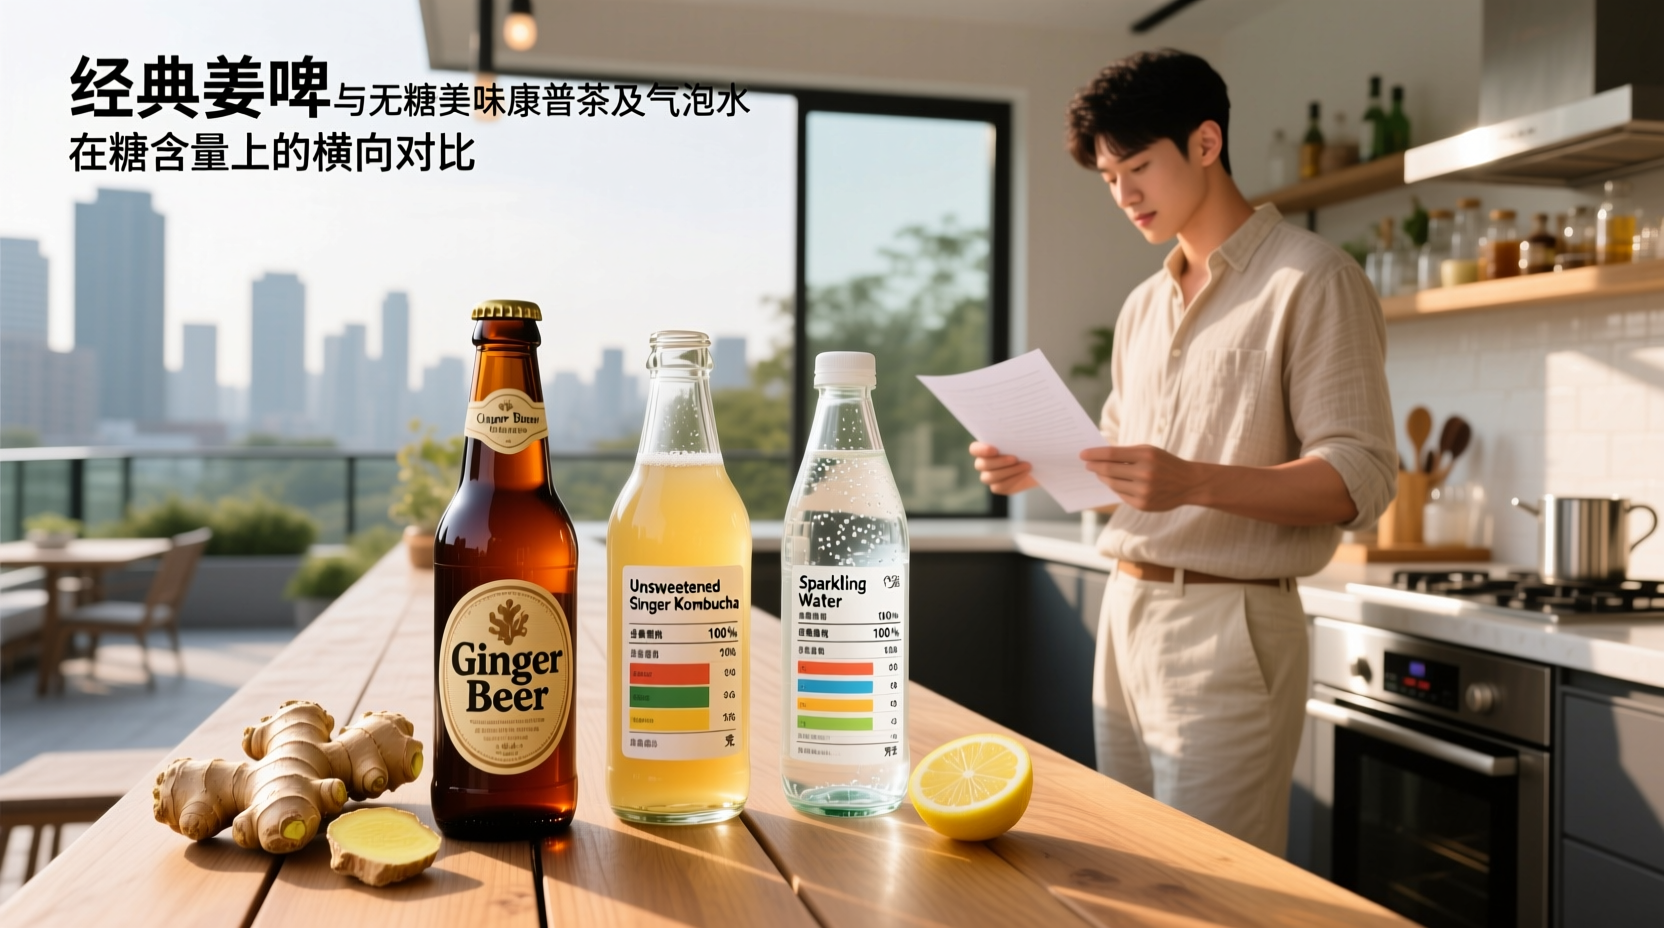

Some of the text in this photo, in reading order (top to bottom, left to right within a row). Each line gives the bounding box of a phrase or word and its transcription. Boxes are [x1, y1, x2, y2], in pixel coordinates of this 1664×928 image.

[629, 578, 721, 595] Unsweetened
[798, 575, 867, 595] Sparkling
[674, 595, 740, 611] Kombucha
[798, 592, 843, 608] Water
[451, 641, 563, 686] Ginger
[466, 679, 549, 713] Beer
